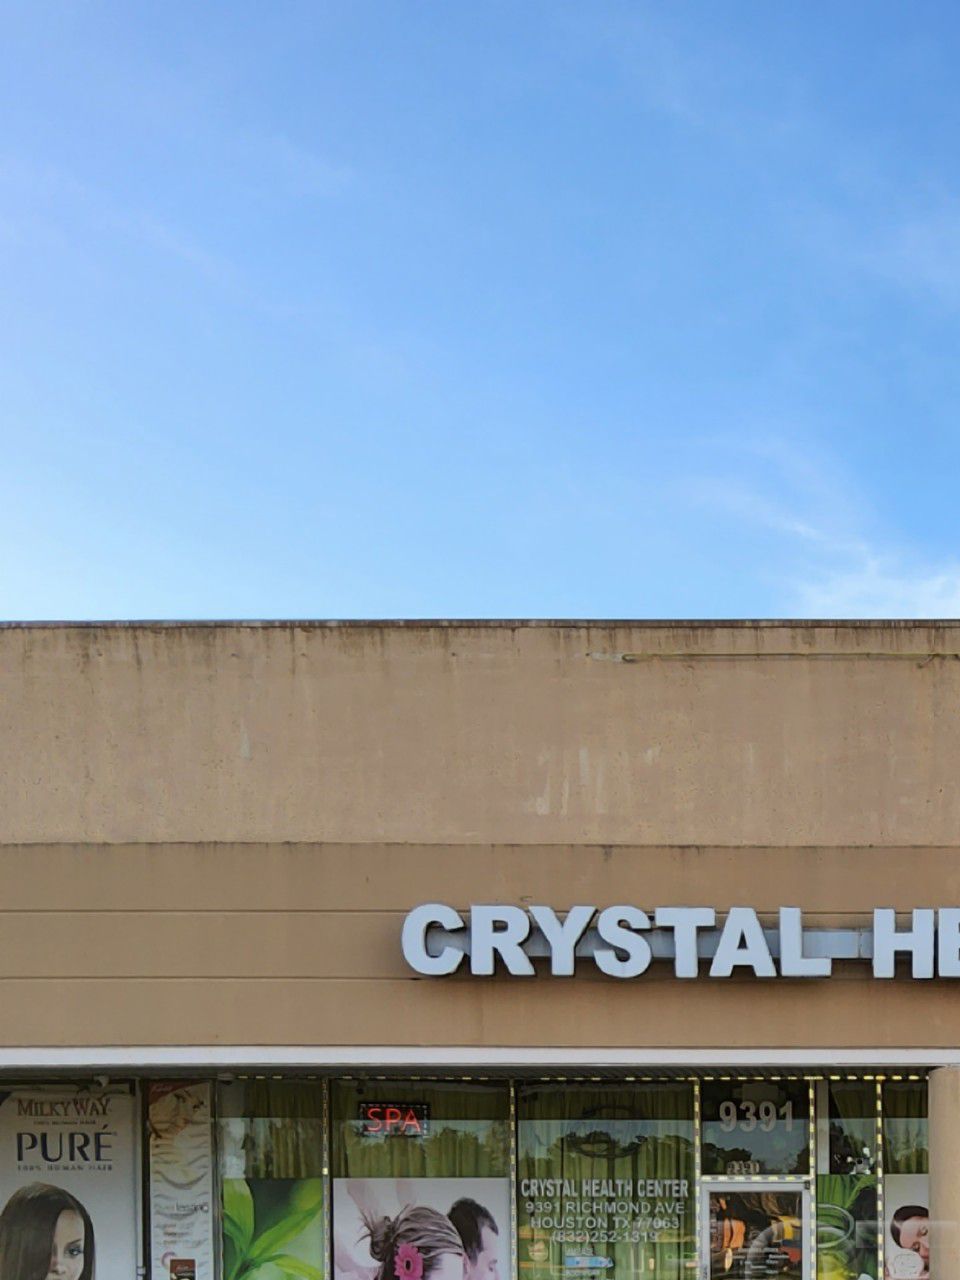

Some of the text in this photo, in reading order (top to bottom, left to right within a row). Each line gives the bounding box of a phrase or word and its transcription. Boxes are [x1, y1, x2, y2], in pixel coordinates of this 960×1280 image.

[401, 903, 832, 978] CRYSTAL
[367, 1107, 421, 1132] SPA
[719, 1101, 793, 1132] 9391
[521, 1178, 688, 1197] CRYSTAL HEALTH CENTER
[525, 1201, 561, 1214] 9391
[565, 1201, 651, 1214] RICHMOND
[530, 1216, 680, 1229] HOUSTON TX 77063
